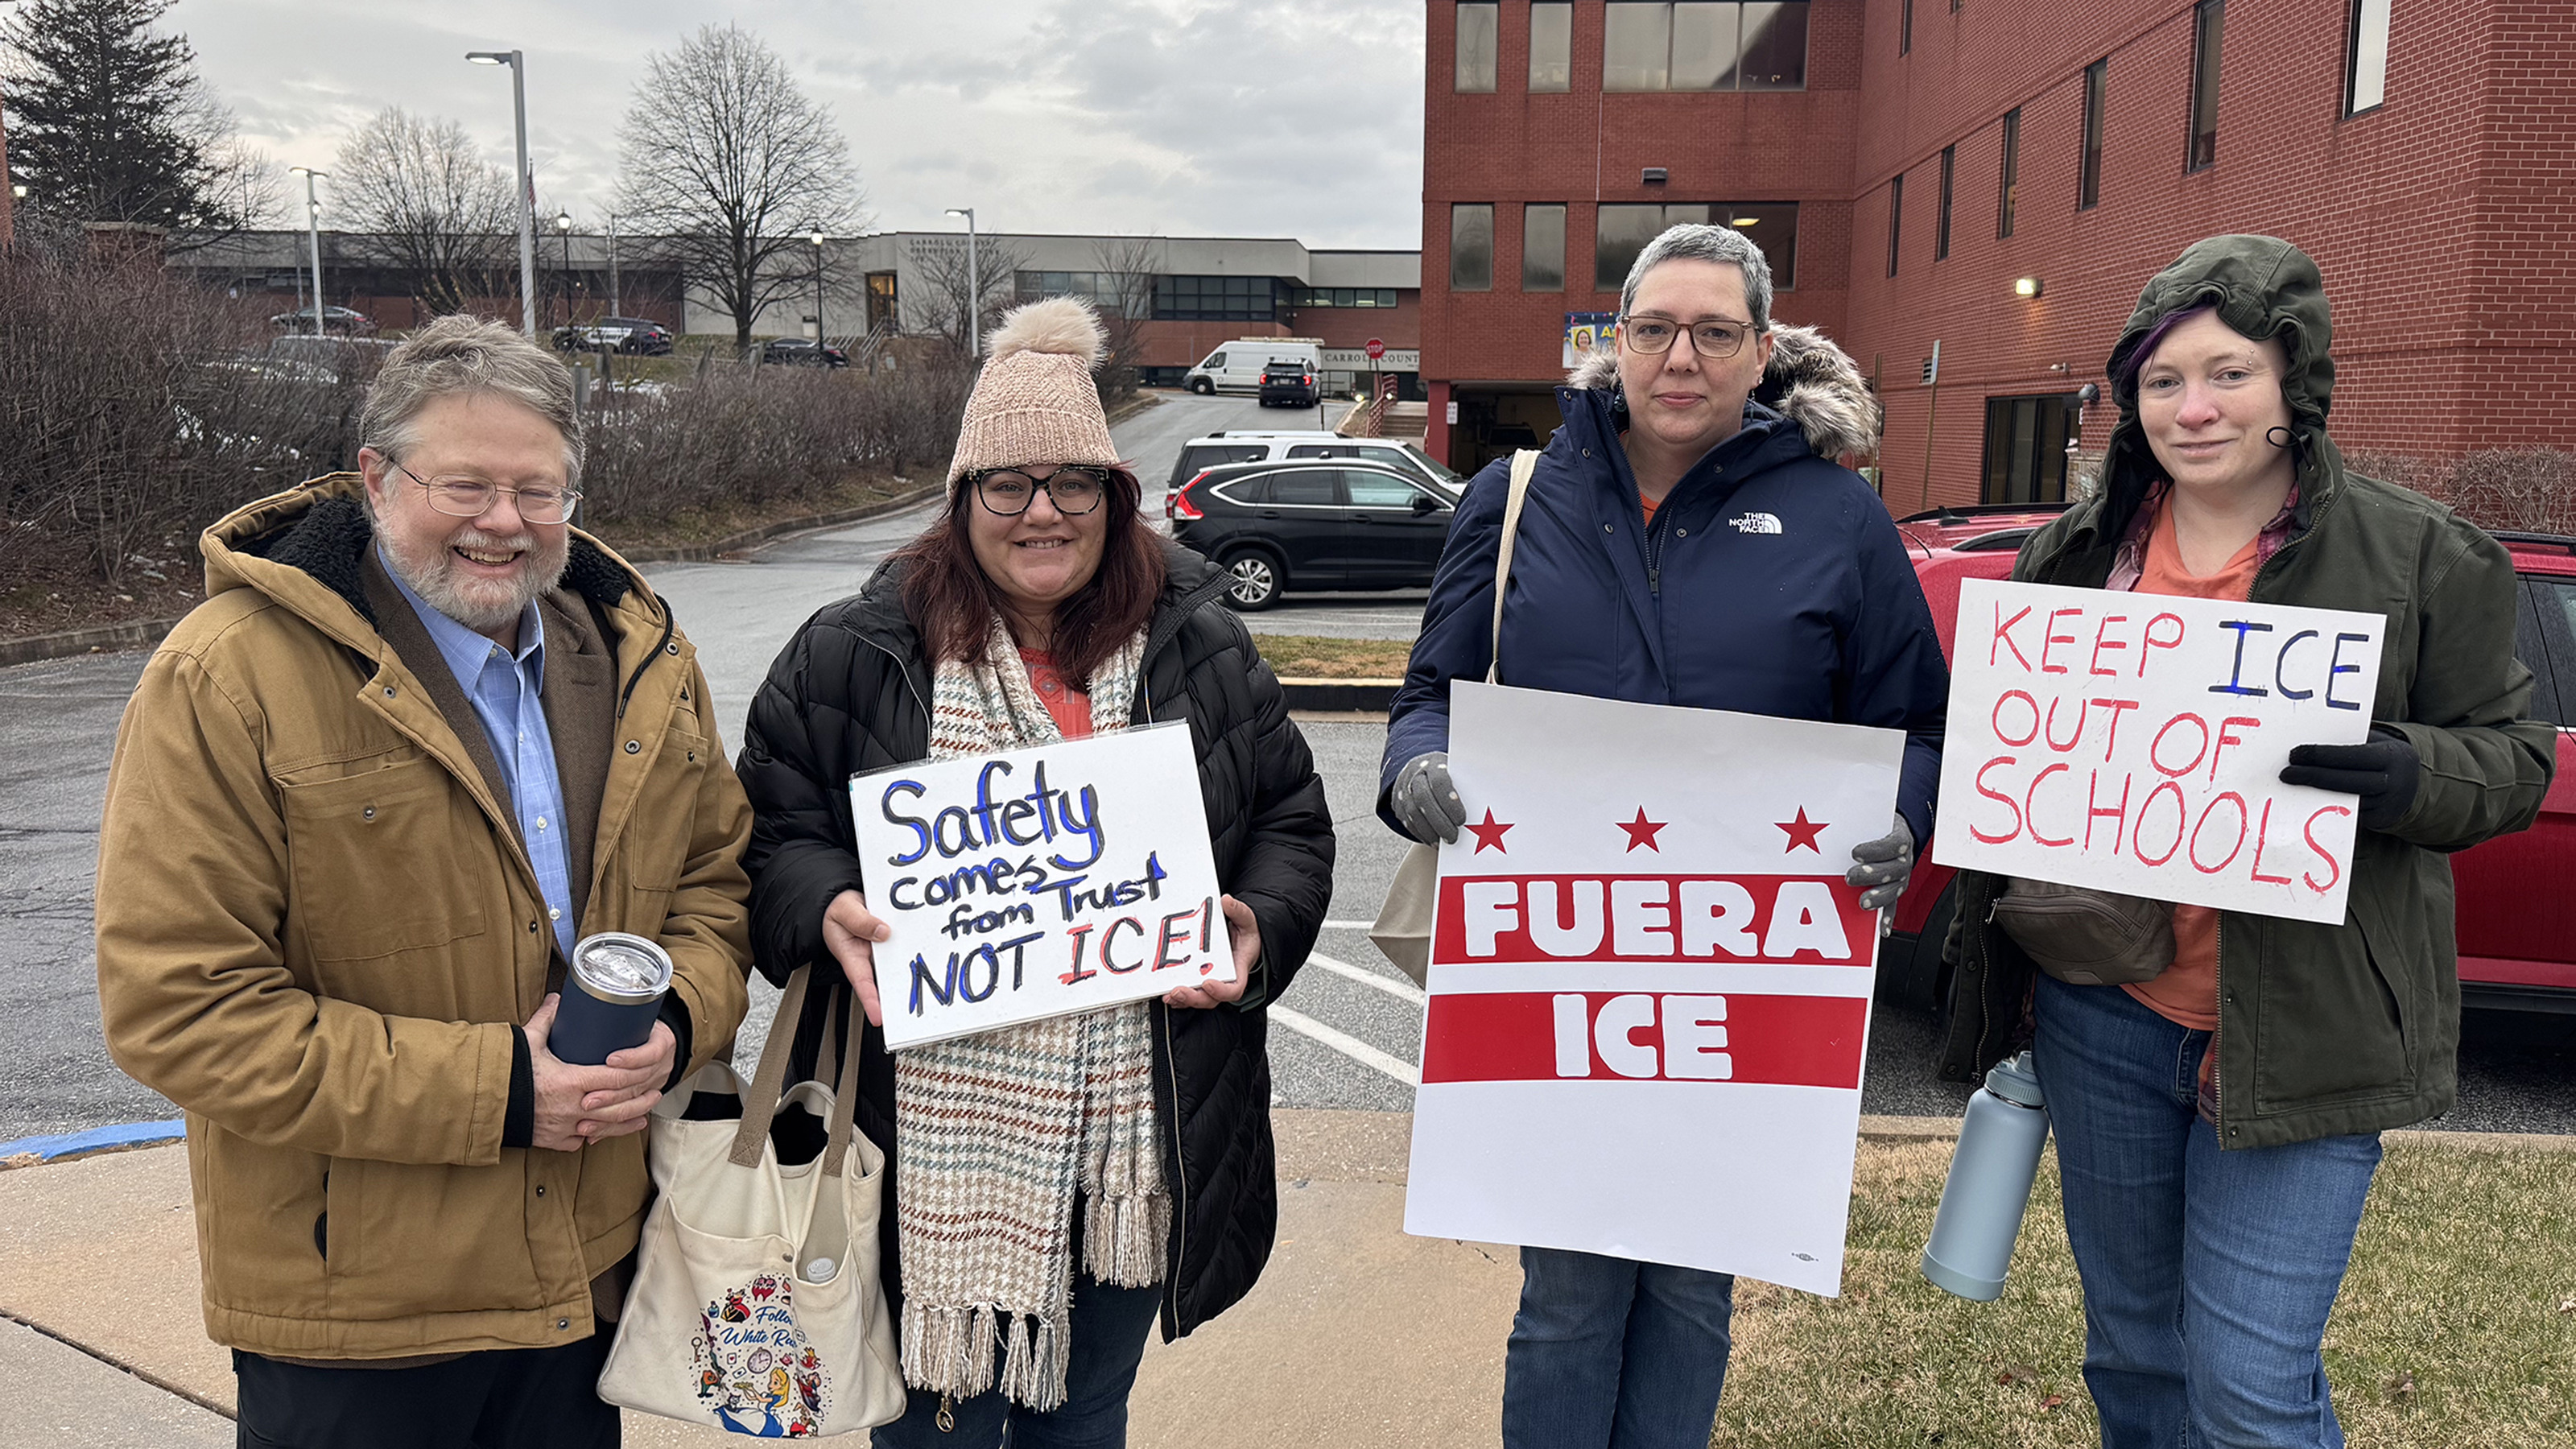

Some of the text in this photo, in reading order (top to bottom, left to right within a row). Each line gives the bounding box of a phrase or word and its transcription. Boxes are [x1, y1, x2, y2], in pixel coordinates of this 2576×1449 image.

[1366, 344, 1384, 354] STOP
[1728, 518, 1765, 527] NORTH
[1739, 526, 1765, 534] FACE
[1744, 512, 1765, 520] THE
[1990, 600, 2370, 711] KEEP ICE
[1992, 689, 2261, 782] OUT OF
[881, 759, 1105, 870] Safety
[1970, 757, 2351, 893] SCHOOLS
[890, 855, 1047, 910] comes
[941, 850, 1167, 940] from Trust
[1463, 880, 1852, 959] FUERA
[909, 897, 1213, 1017] NOT ICE!
[1552, 993, 1733, 1080] ICE
[720, 1327, 769, 1346] White
